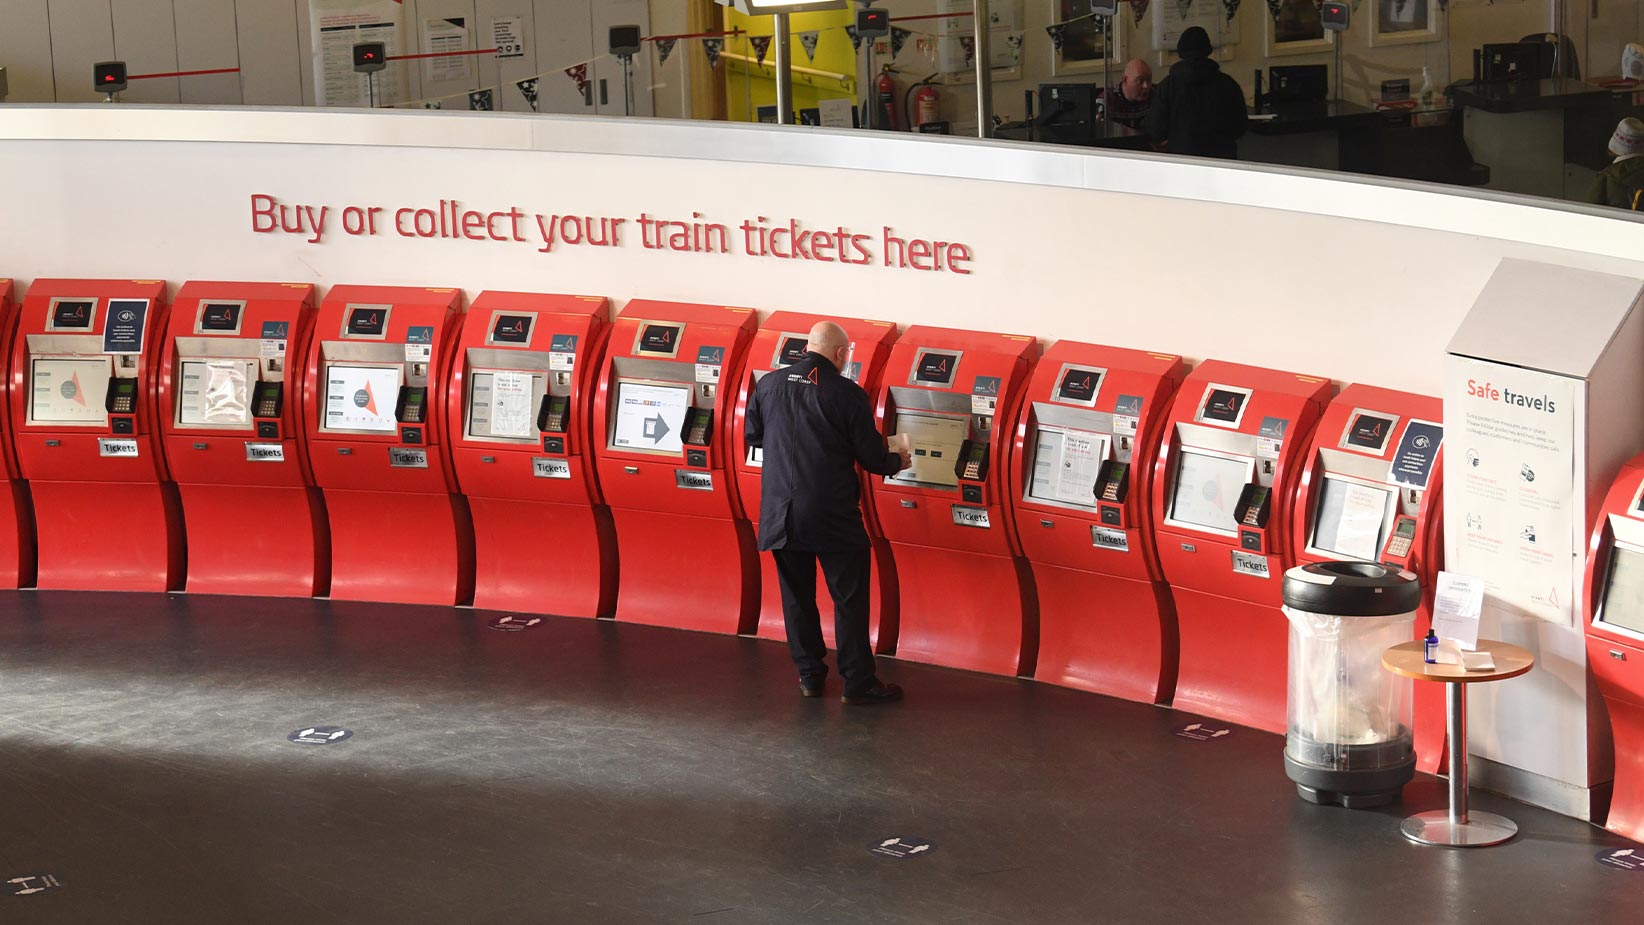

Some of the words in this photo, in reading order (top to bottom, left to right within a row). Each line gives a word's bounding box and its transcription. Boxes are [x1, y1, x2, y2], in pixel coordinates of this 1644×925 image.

[251, 194, 327, 243] Buy
[342, 206, 382, 236] or
[395, 199, 526, 242] collect
[536, 214, 625, 253] your
[636, 212, 728, 253] train
[740, 216, 870, 264] tickets
[883, 226, 971, 274] here
[1467, 379, 1500, 401] Safe
[1504, 388, 1555, 413] travels
[104, 443, 136, 452] Tickets
[250, 447, 282, 457] Tickets
[393, 453, 425, 463] Tickets
[536, 463, 567, 473] Tickets
[681, 475, 711, 486] Tickets
[957, 511, 988, 523] Tickets
[1096, 533, 1127, 545] Tickets
[1237, 558, 1268, 572] Tickets
